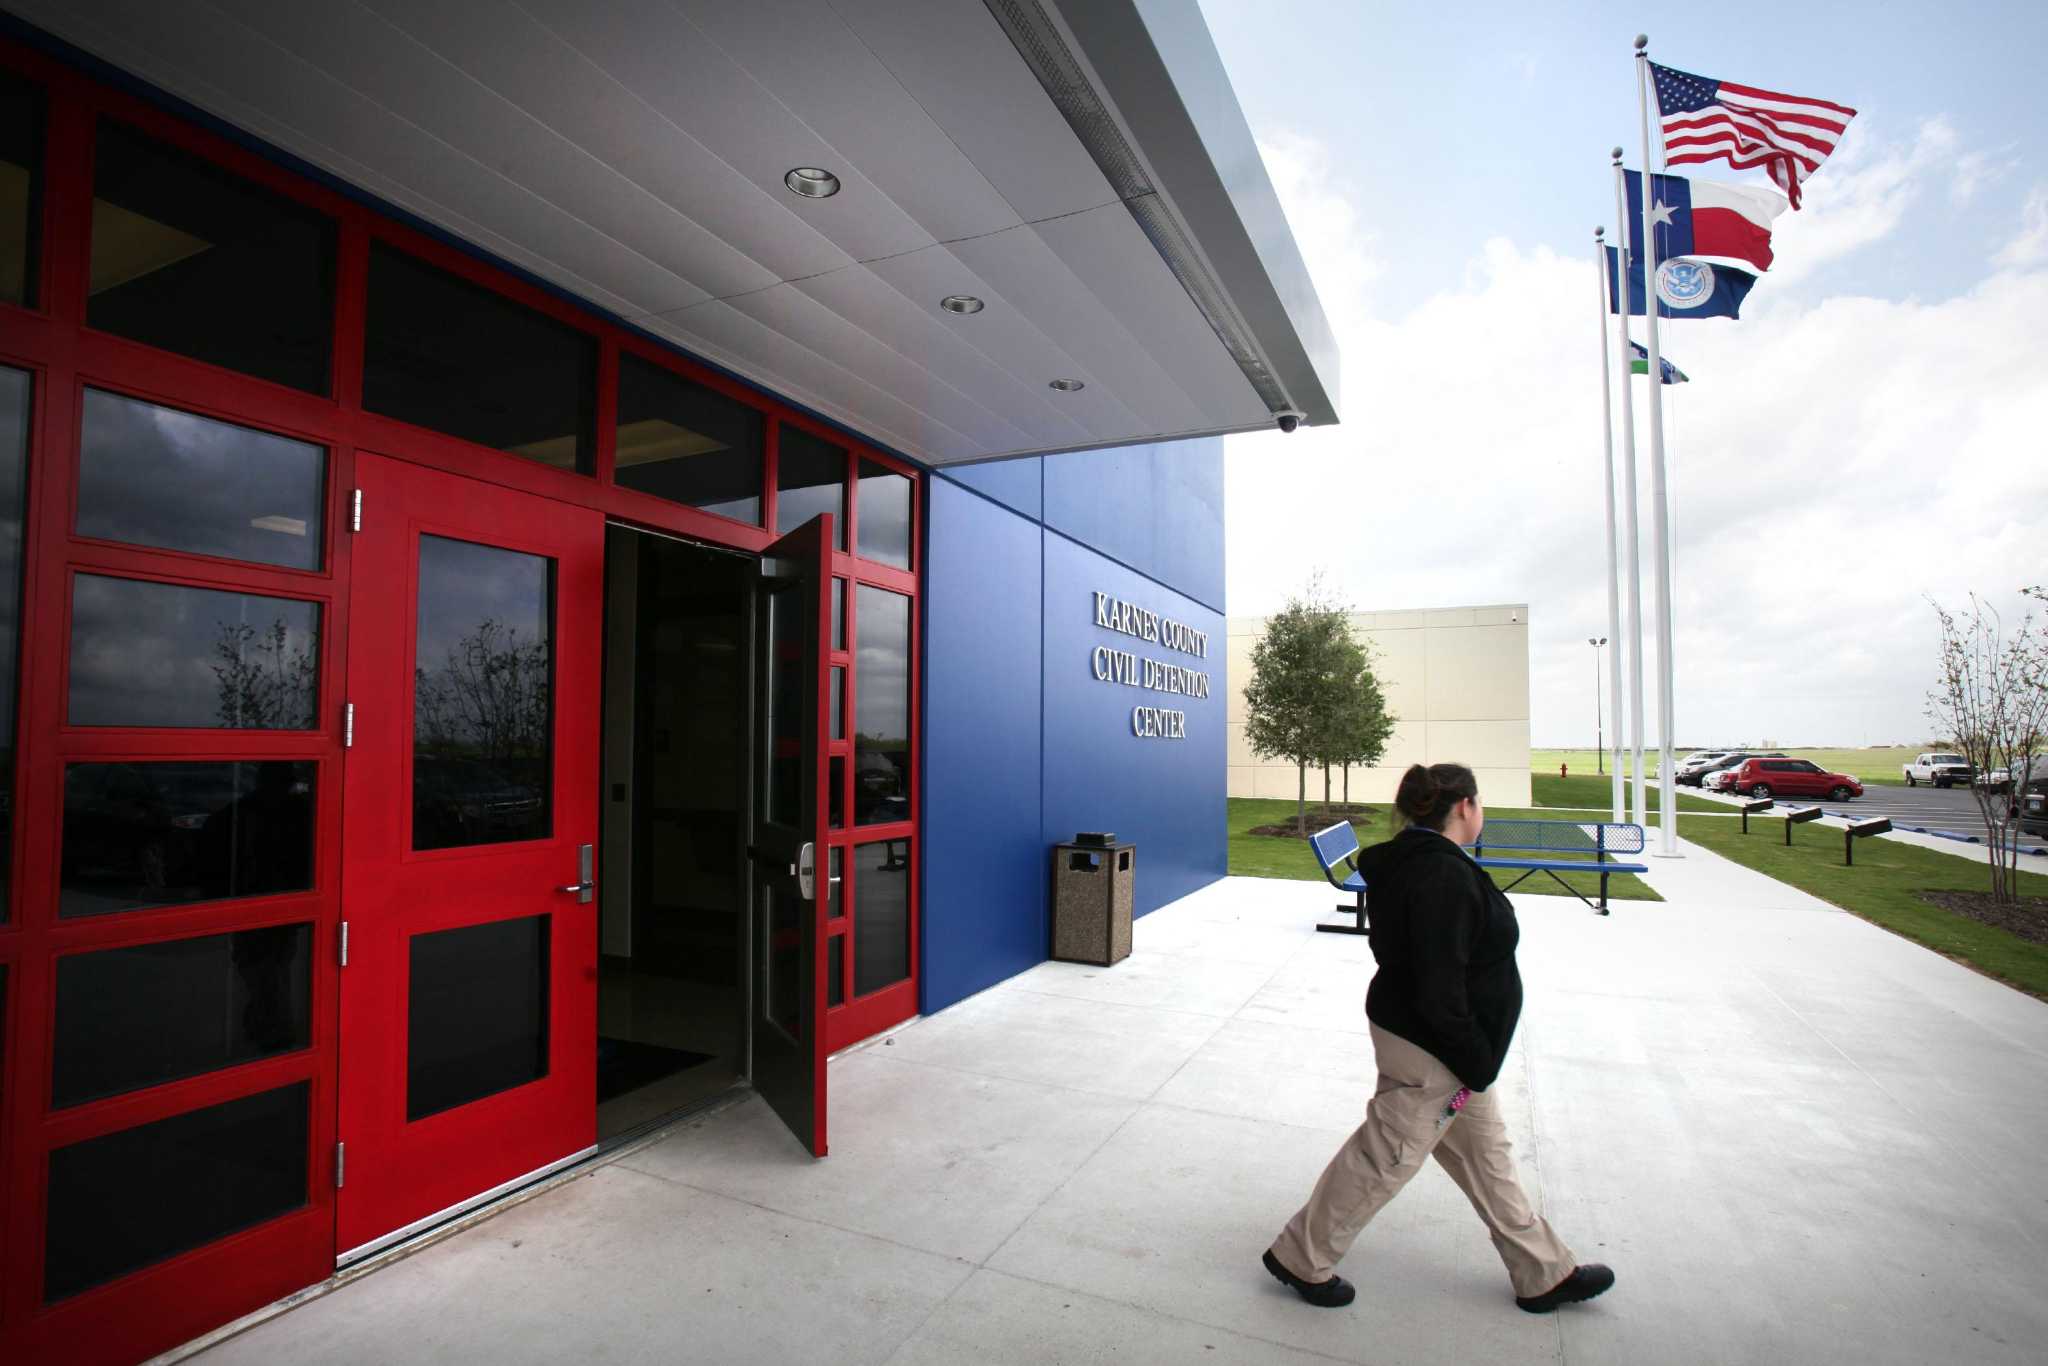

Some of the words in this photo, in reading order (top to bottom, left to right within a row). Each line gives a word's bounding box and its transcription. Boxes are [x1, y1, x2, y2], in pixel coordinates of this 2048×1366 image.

[1094, 592, 1159, 643] KARNES
[1162, 618, 1208, 658] COUNTY
[1093, 646, 1139, 686] CIVIL
[1144, 657, 1209, 698] DETENTION
[1133, 706, 1185, 738] CENTER
